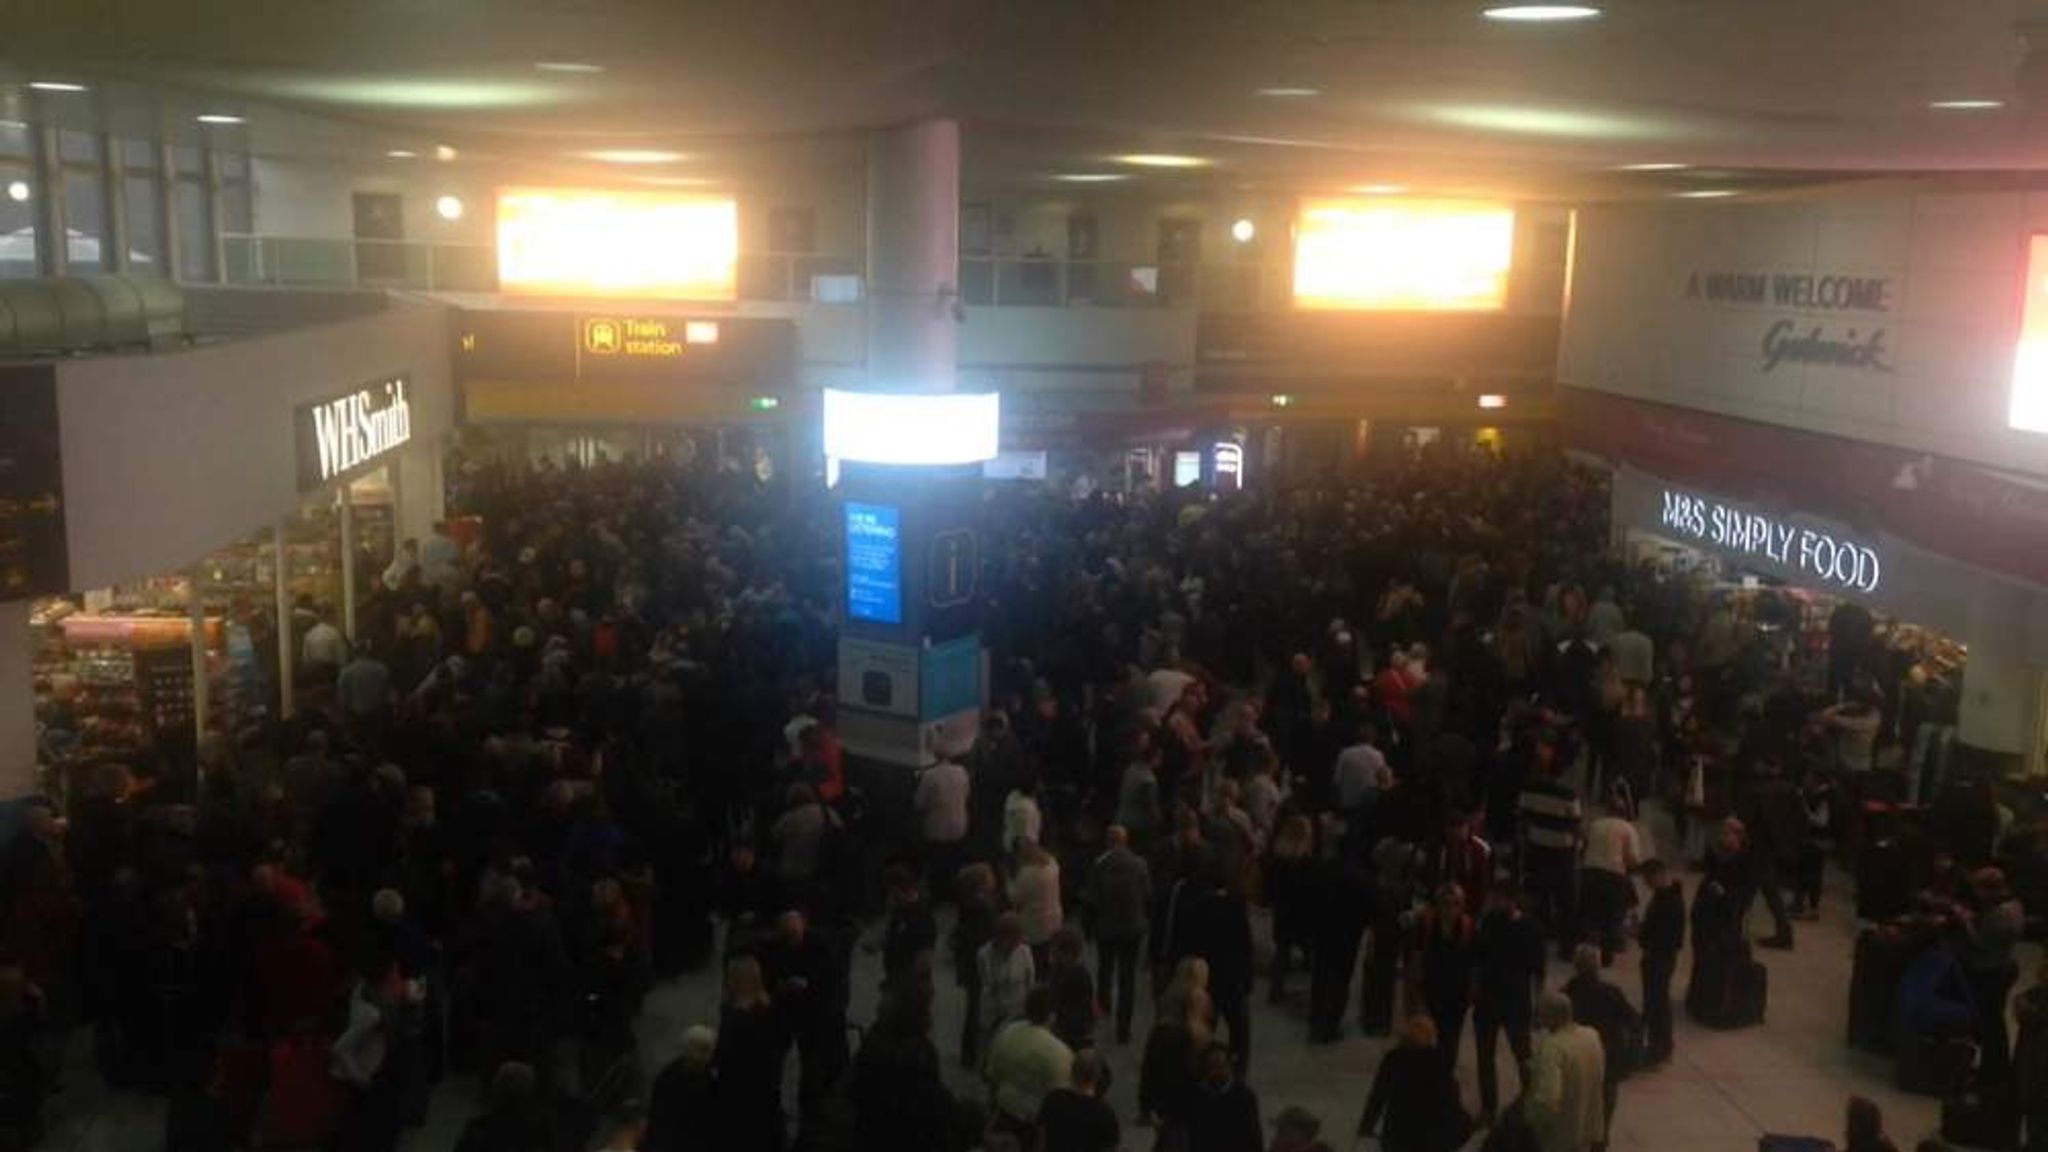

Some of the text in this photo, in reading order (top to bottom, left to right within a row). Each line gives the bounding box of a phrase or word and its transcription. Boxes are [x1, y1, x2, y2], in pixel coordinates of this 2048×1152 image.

[1773, 274, 1890, 312] WELCOME
[623, 319, 666, 338] Train
[625, 339, 682, 356] station
[311, 379, 411, 480] WHSmith
[1662, 490, 1880, 592] M&S SIMPLY FOOD
